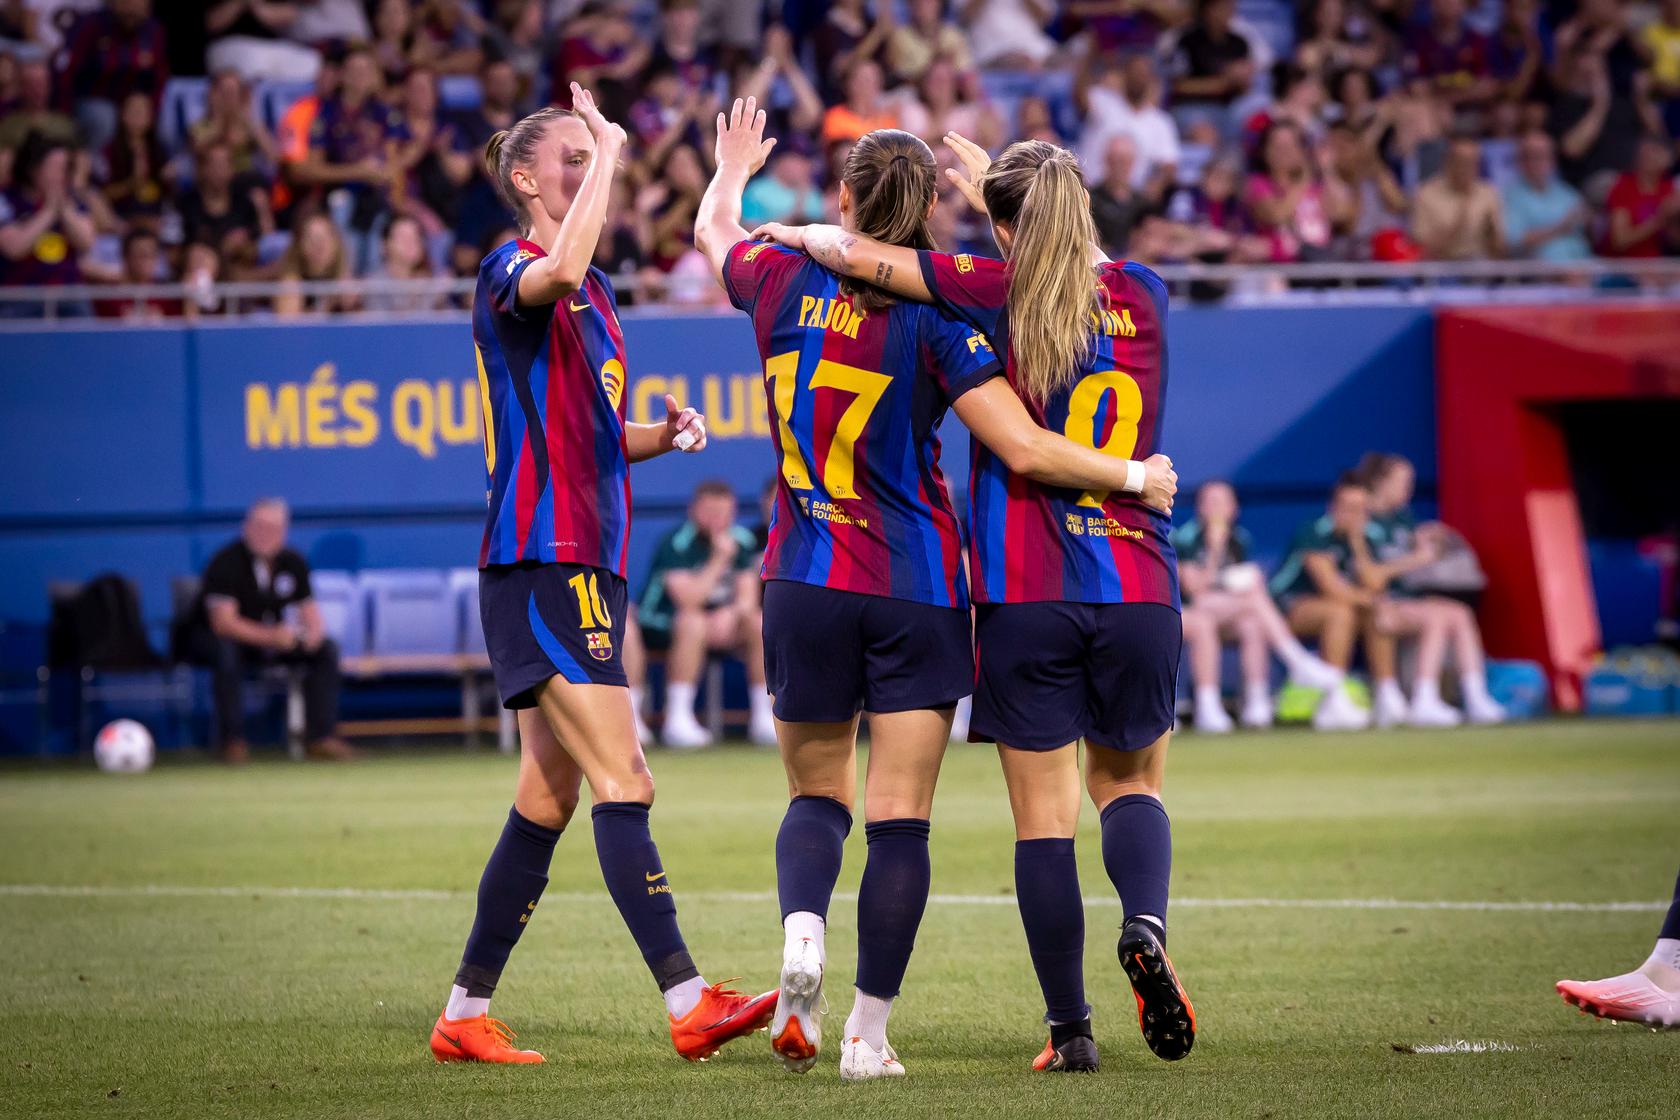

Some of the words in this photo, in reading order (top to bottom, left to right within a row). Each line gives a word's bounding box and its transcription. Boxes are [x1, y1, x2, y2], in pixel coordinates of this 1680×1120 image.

[246, 363, 378, 448] MÉS
[392, 380, 484, 457] QU
[765, 350, 894, 500] 17
[1064, 370, 1143, 514] 9
[1087, 517, 1121, 528] BARÇA
[568, 572, 612, 629] 10
